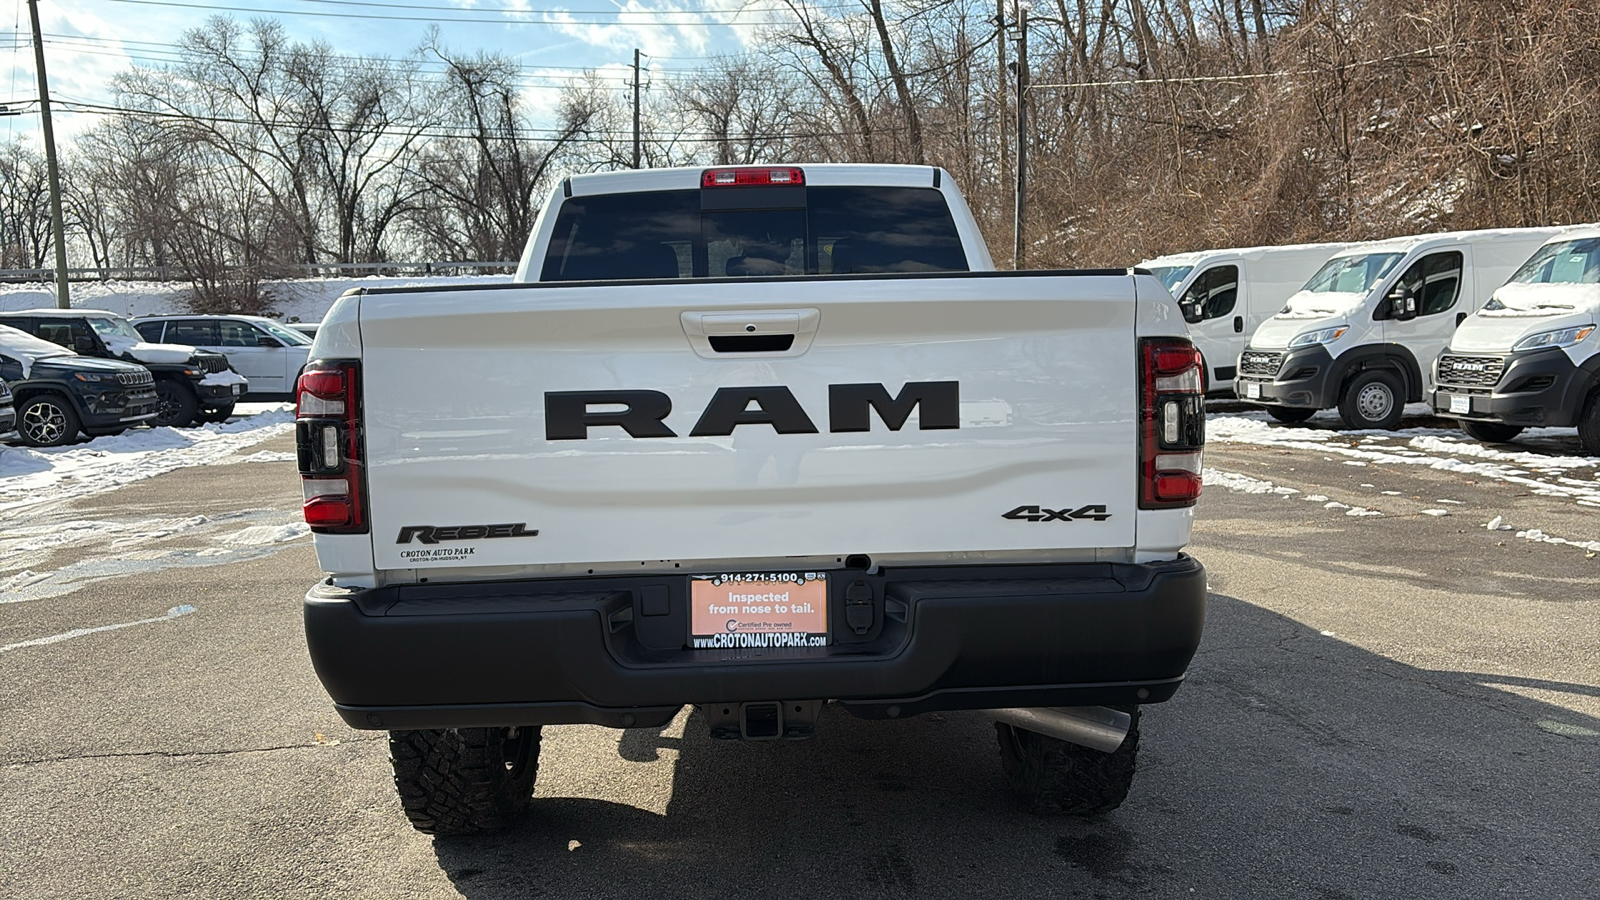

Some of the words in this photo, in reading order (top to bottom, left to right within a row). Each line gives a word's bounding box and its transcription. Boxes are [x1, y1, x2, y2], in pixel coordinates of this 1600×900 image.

[1452, 363, 1484, 371] RAM
[544, 381, 960, 440] RAM
[1001, 504, 1113, 522] 4x4
[396, 522, 539, 545] REBEL
[400, 550, 431, 558] CROTON
[432, 548, 453, 557] AUTO
[454, 547, 475, 555] PARK
[728, 592, 789, 604] Inspected
[708, 604, 739, 614] from
[742, 604, 772, 614] nose
[774, 604, 788, 614] to
[791, 603, 815, 613] tail.
